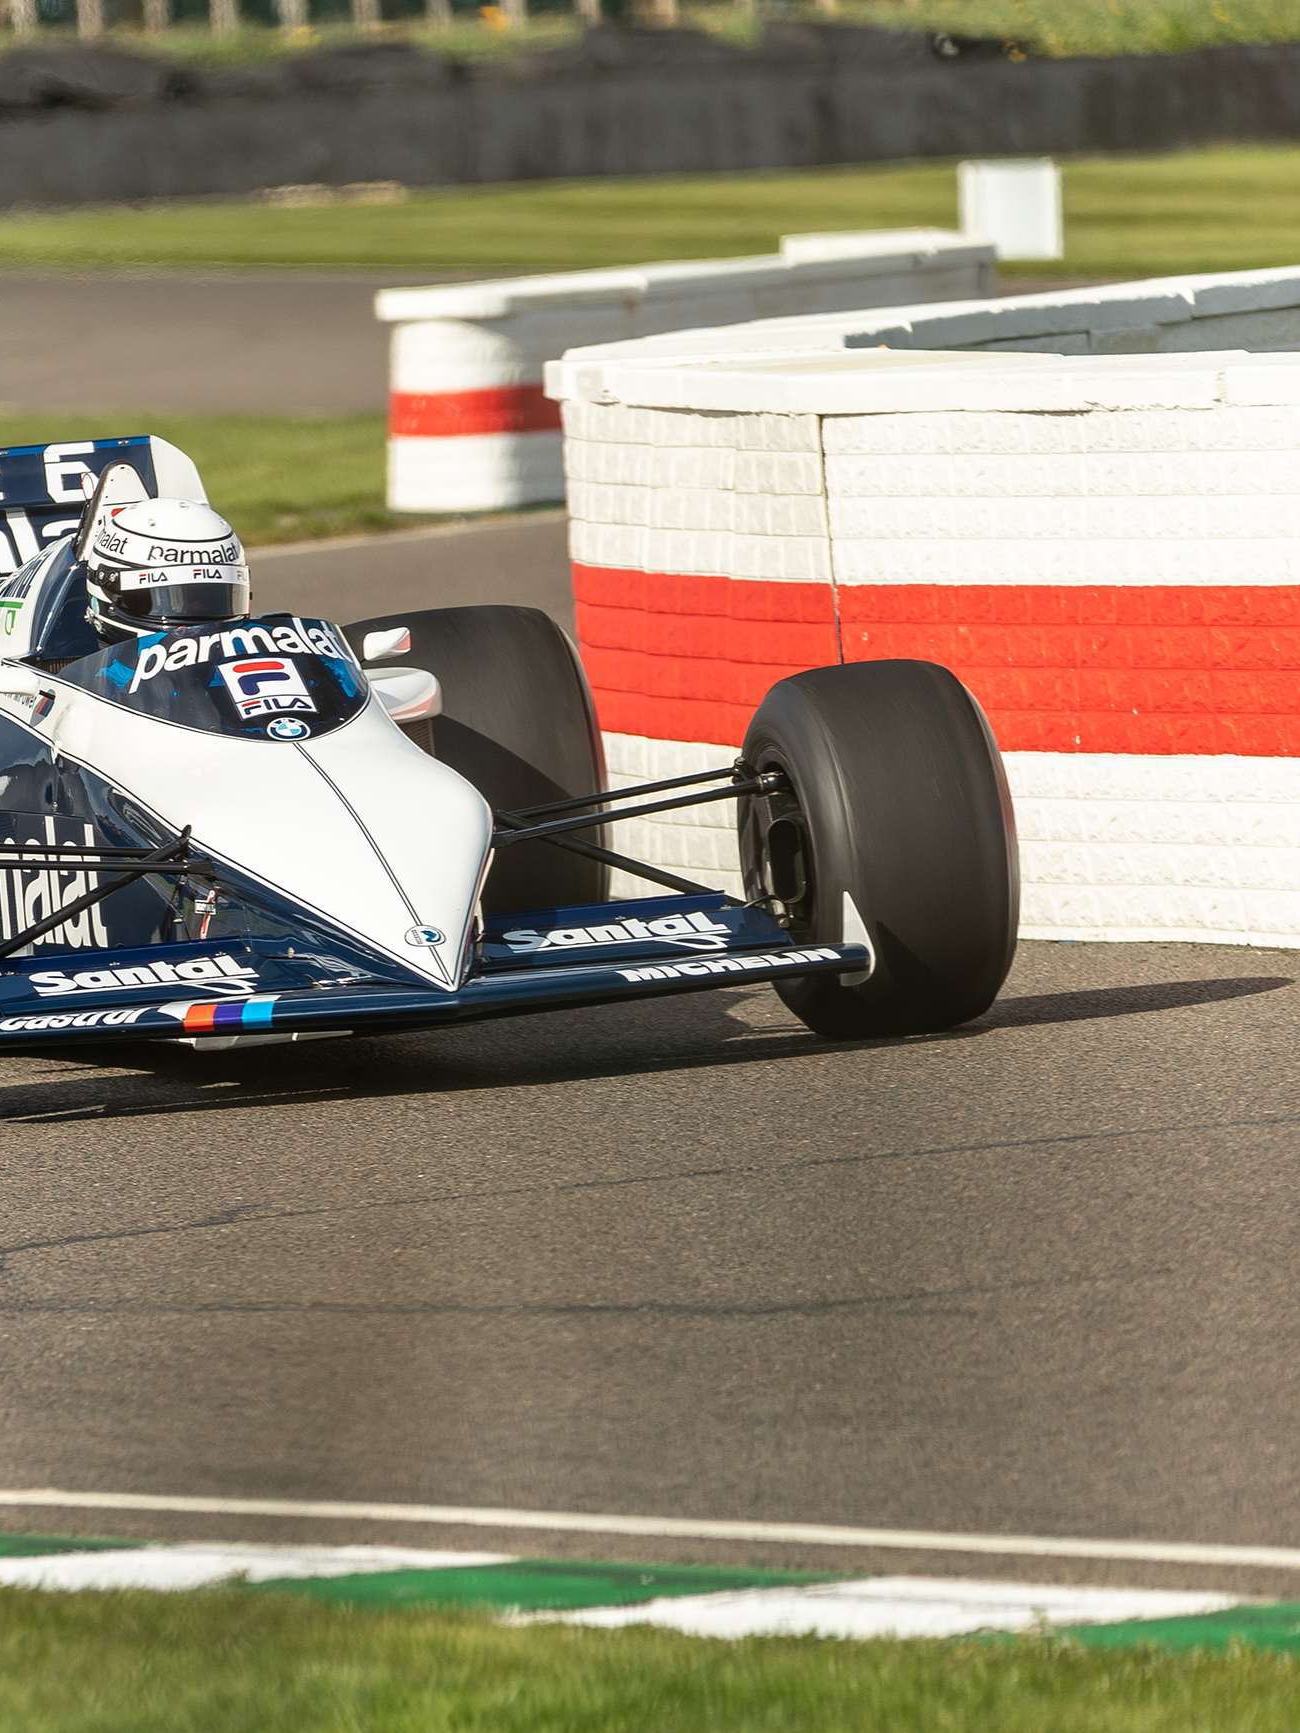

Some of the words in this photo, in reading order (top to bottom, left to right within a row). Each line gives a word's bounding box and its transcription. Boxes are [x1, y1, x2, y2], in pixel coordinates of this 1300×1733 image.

[43, 441, 100, 504] 6
[147, 543, 239, 564] parmalat
[139, 571, 168, 584] FILA
[193, 568, 222, 580] FILA
[128, 617, 353, 694] parmalat
[241, 697, 312, 715] FILA
[616, 948, 842, 982] MICHELIN
